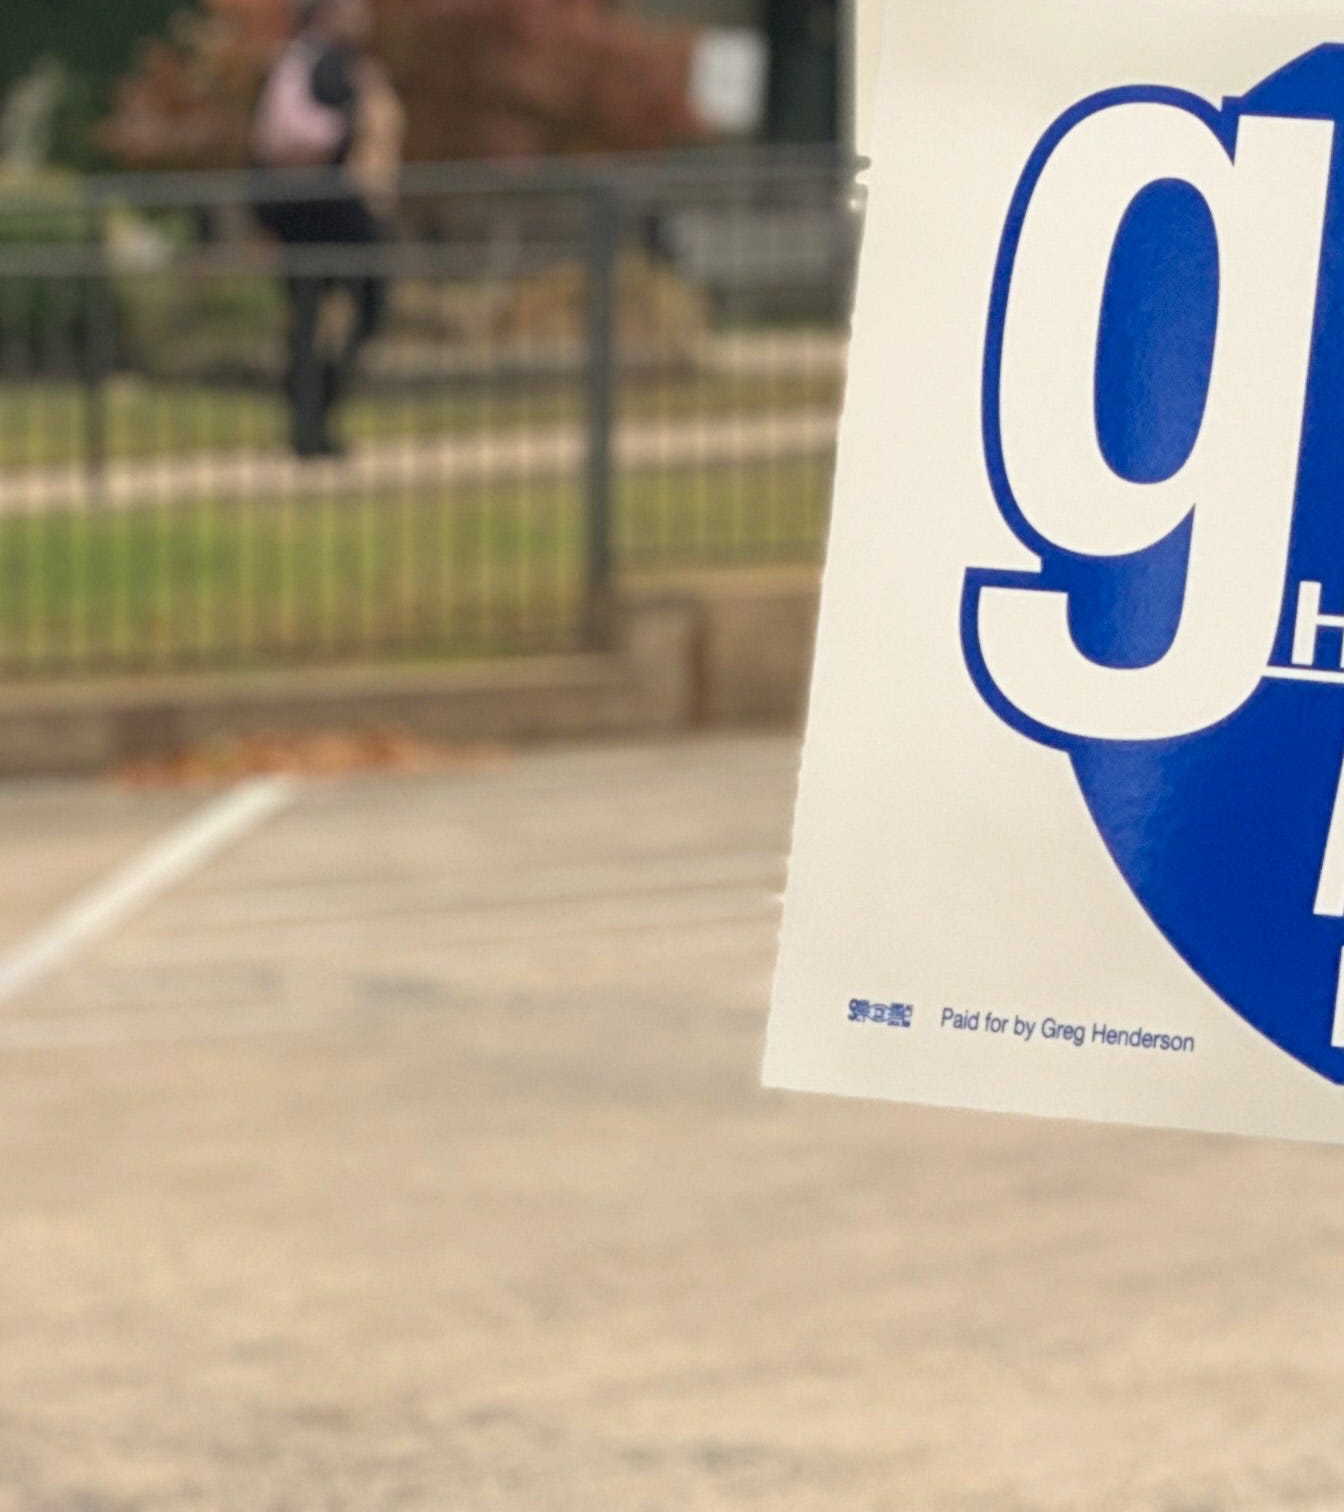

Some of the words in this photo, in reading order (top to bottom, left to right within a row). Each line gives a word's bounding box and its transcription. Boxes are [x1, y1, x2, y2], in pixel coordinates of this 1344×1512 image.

[940, 1007, 980, 1031] Paid
[984, 1011, 1010, 1034] for
[1013, 1014, 1037, 1042] by
[1041, 1017, 1086, 1047] Greg
[1091, 1023, 1196, 1053] Henderson
